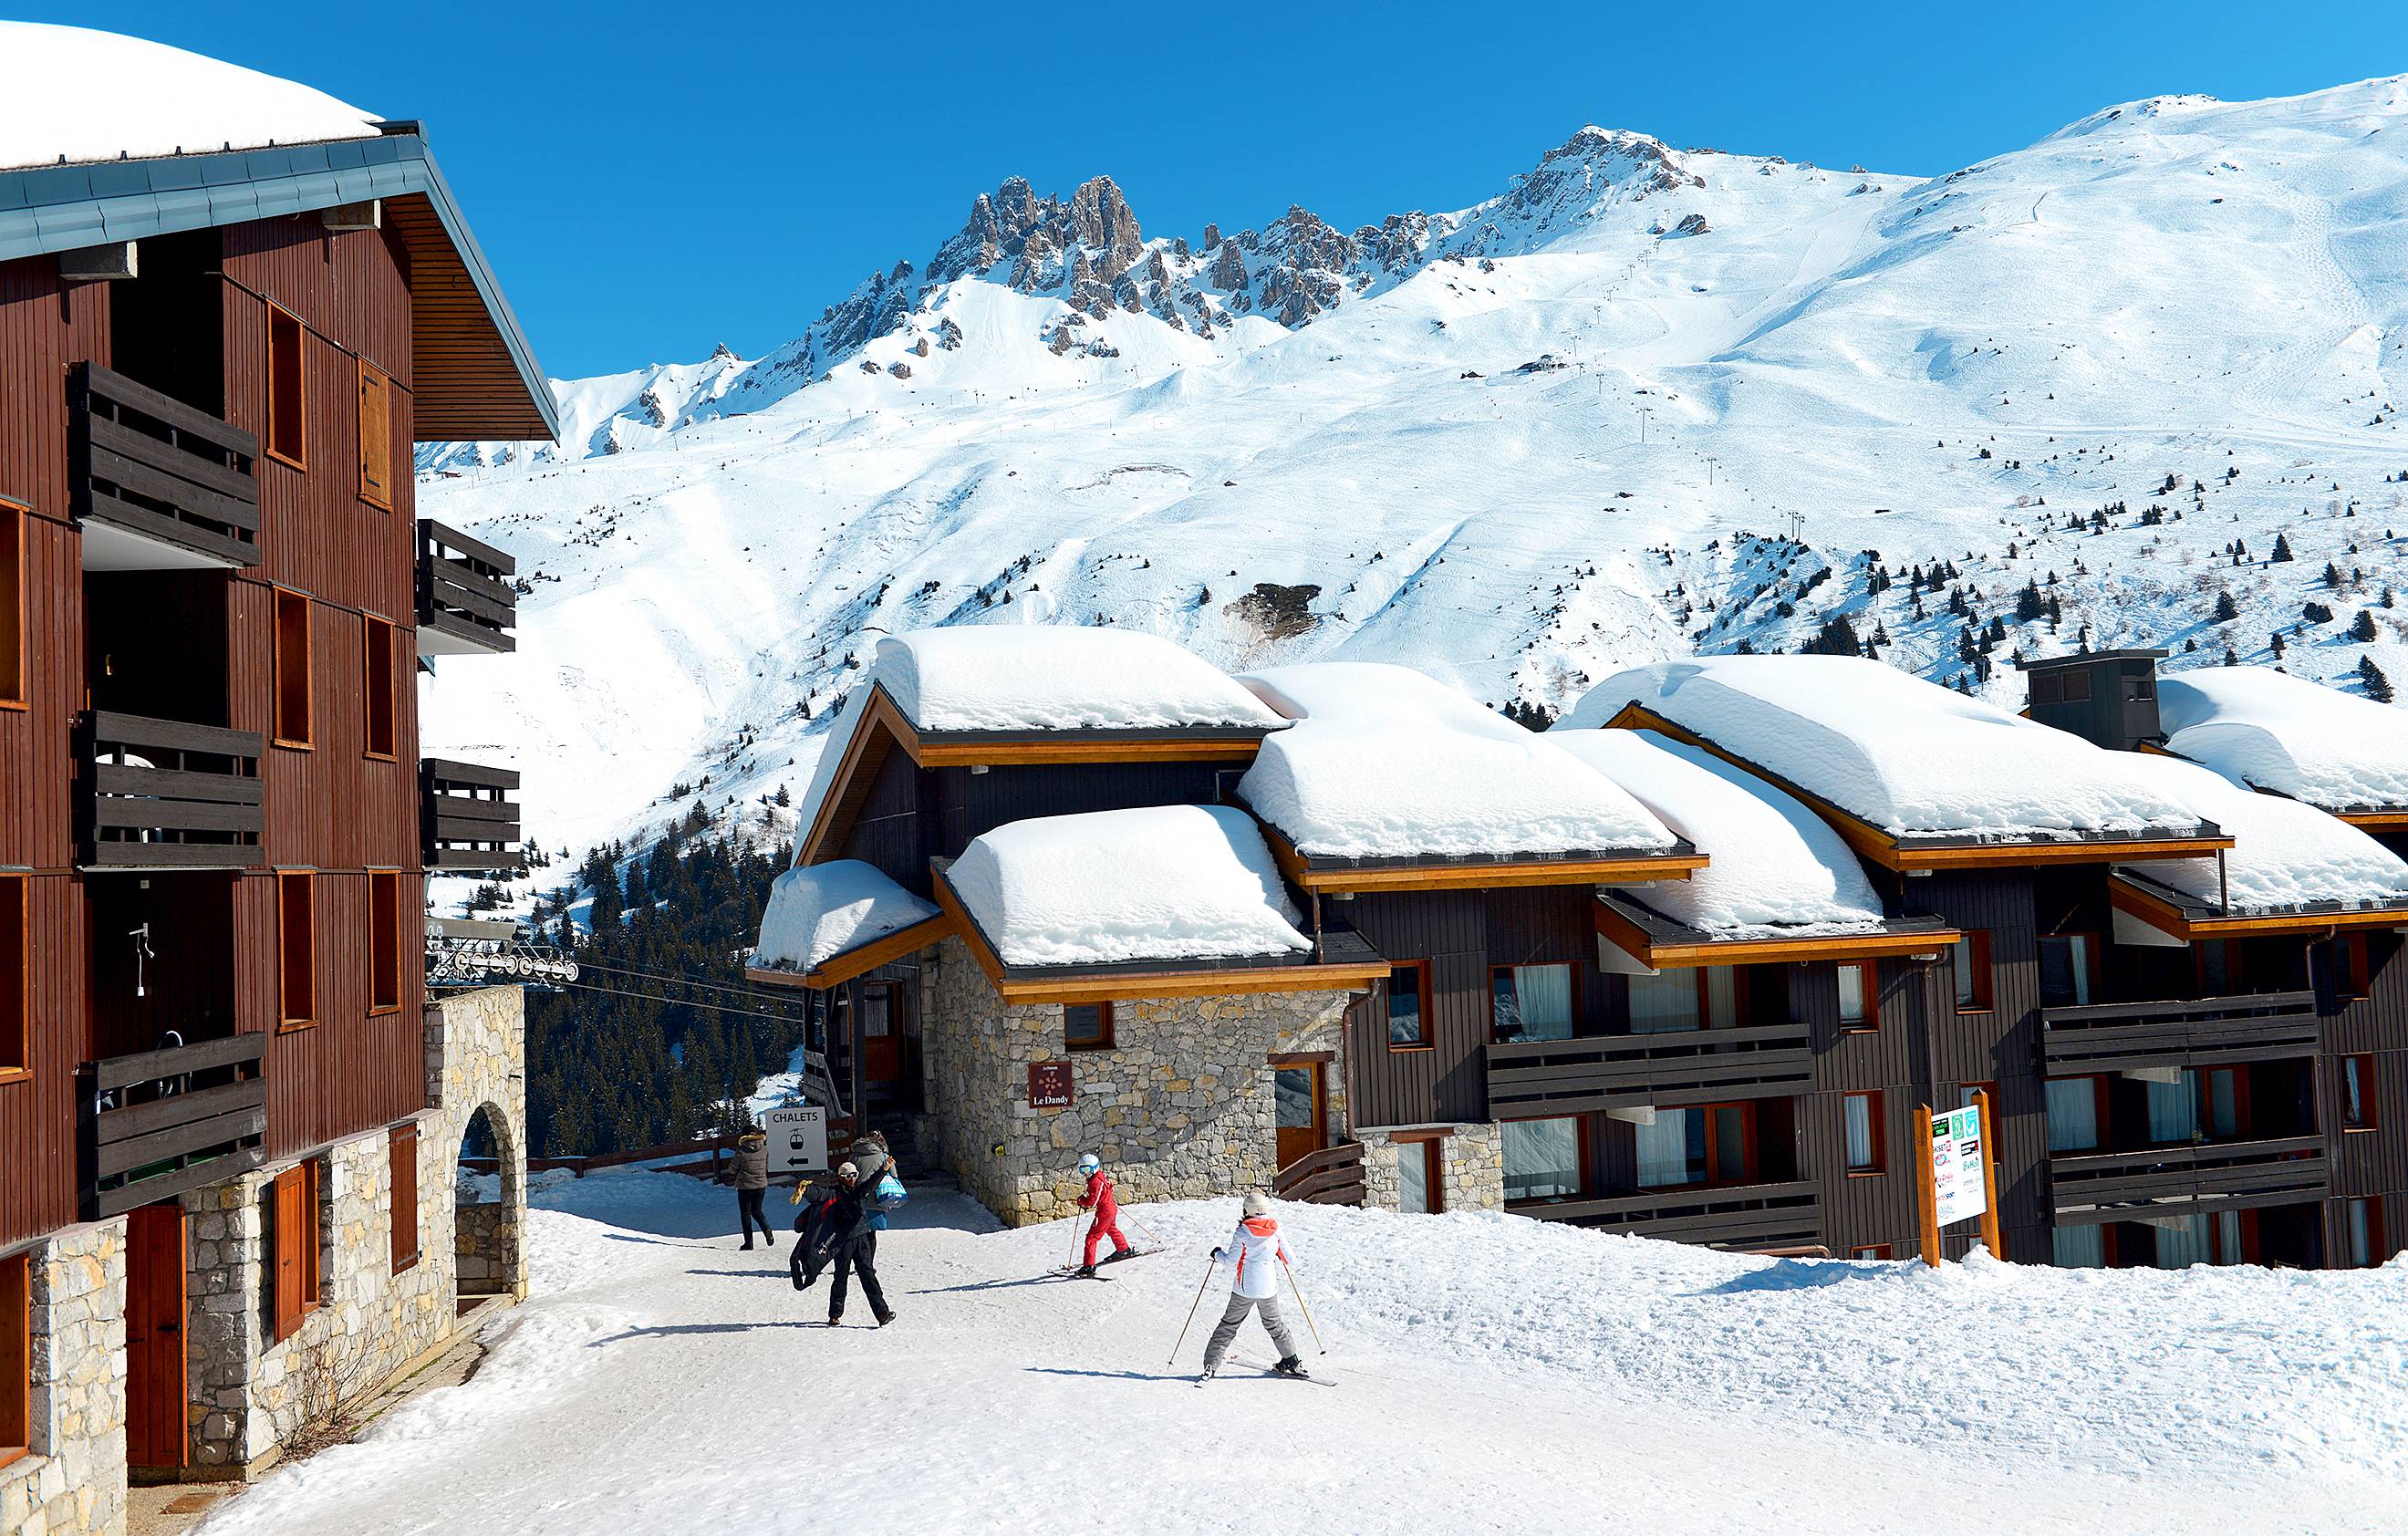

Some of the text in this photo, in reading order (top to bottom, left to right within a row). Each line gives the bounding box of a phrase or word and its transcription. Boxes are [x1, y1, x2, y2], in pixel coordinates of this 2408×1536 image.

[1033, 1095, 1069, 1105] Le Dandy
[773, 1112, 818, 1123] CHALETS
